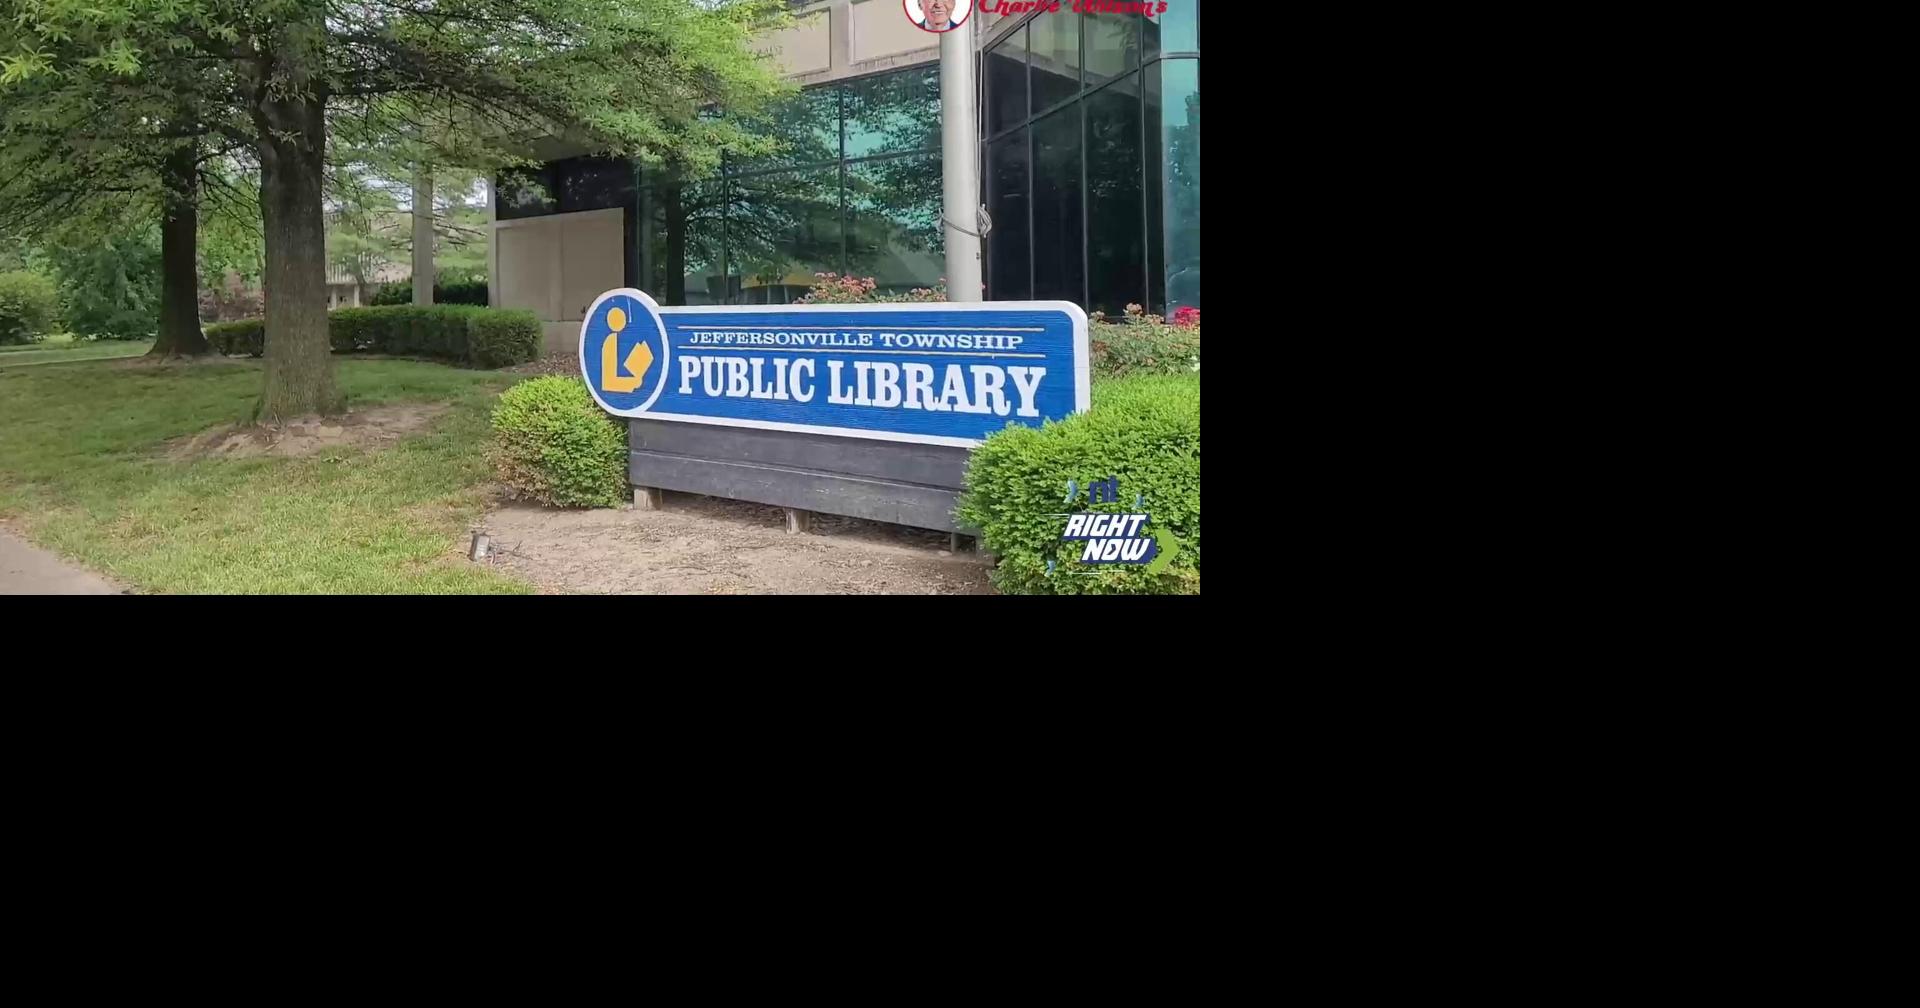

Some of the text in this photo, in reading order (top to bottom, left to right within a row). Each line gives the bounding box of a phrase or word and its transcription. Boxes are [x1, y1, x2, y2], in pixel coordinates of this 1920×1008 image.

[690, 332, 1023, 349] JEFFERSONVILLE TOWNSHIP
[678, 356, 1046, 417] PUBLIC LIBRARY
